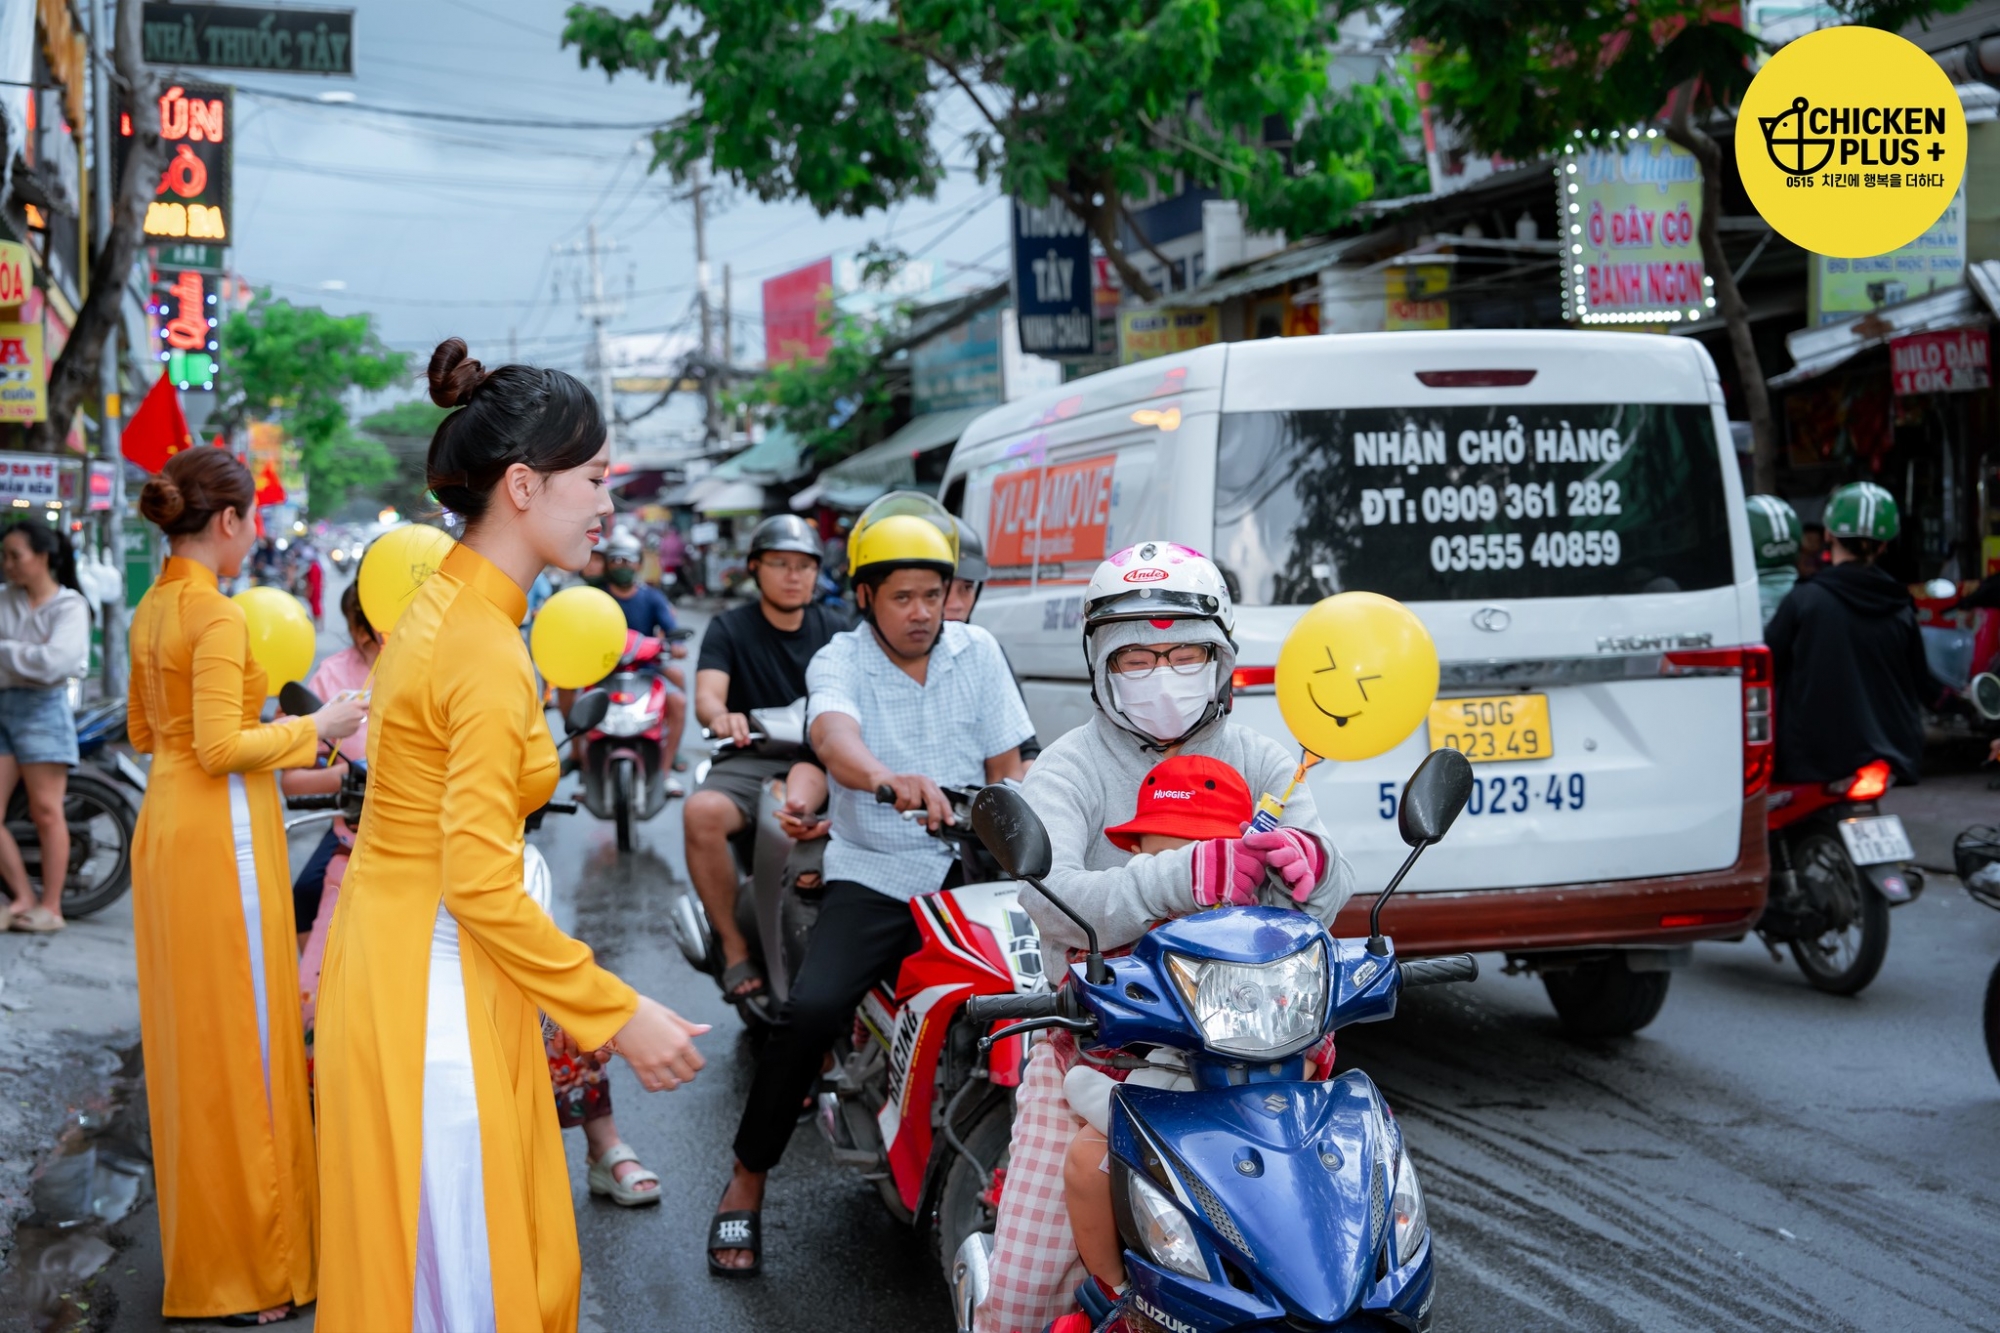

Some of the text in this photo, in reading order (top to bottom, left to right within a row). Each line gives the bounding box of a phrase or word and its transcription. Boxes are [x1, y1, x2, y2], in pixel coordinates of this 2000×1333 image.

[143, 12, 349, 71] NHÀ THUỐC TÂY
[1661, 200, 1694, 245] CÓ
[1031, 248, 1075, 302] TÂY
[1588, 251, 1643, 306] BÁNH
[1354, 415, 1621, 475] NHẬN CHỞ HÀNG
[1360, 480, 1622, 526] ĐT: 0909 361 282
[1430, 530, 1621, 572] 03555 40859
[1463, 701, 1514, 727] 50G
[1153, 789, 1191, 800] HUGGIES
